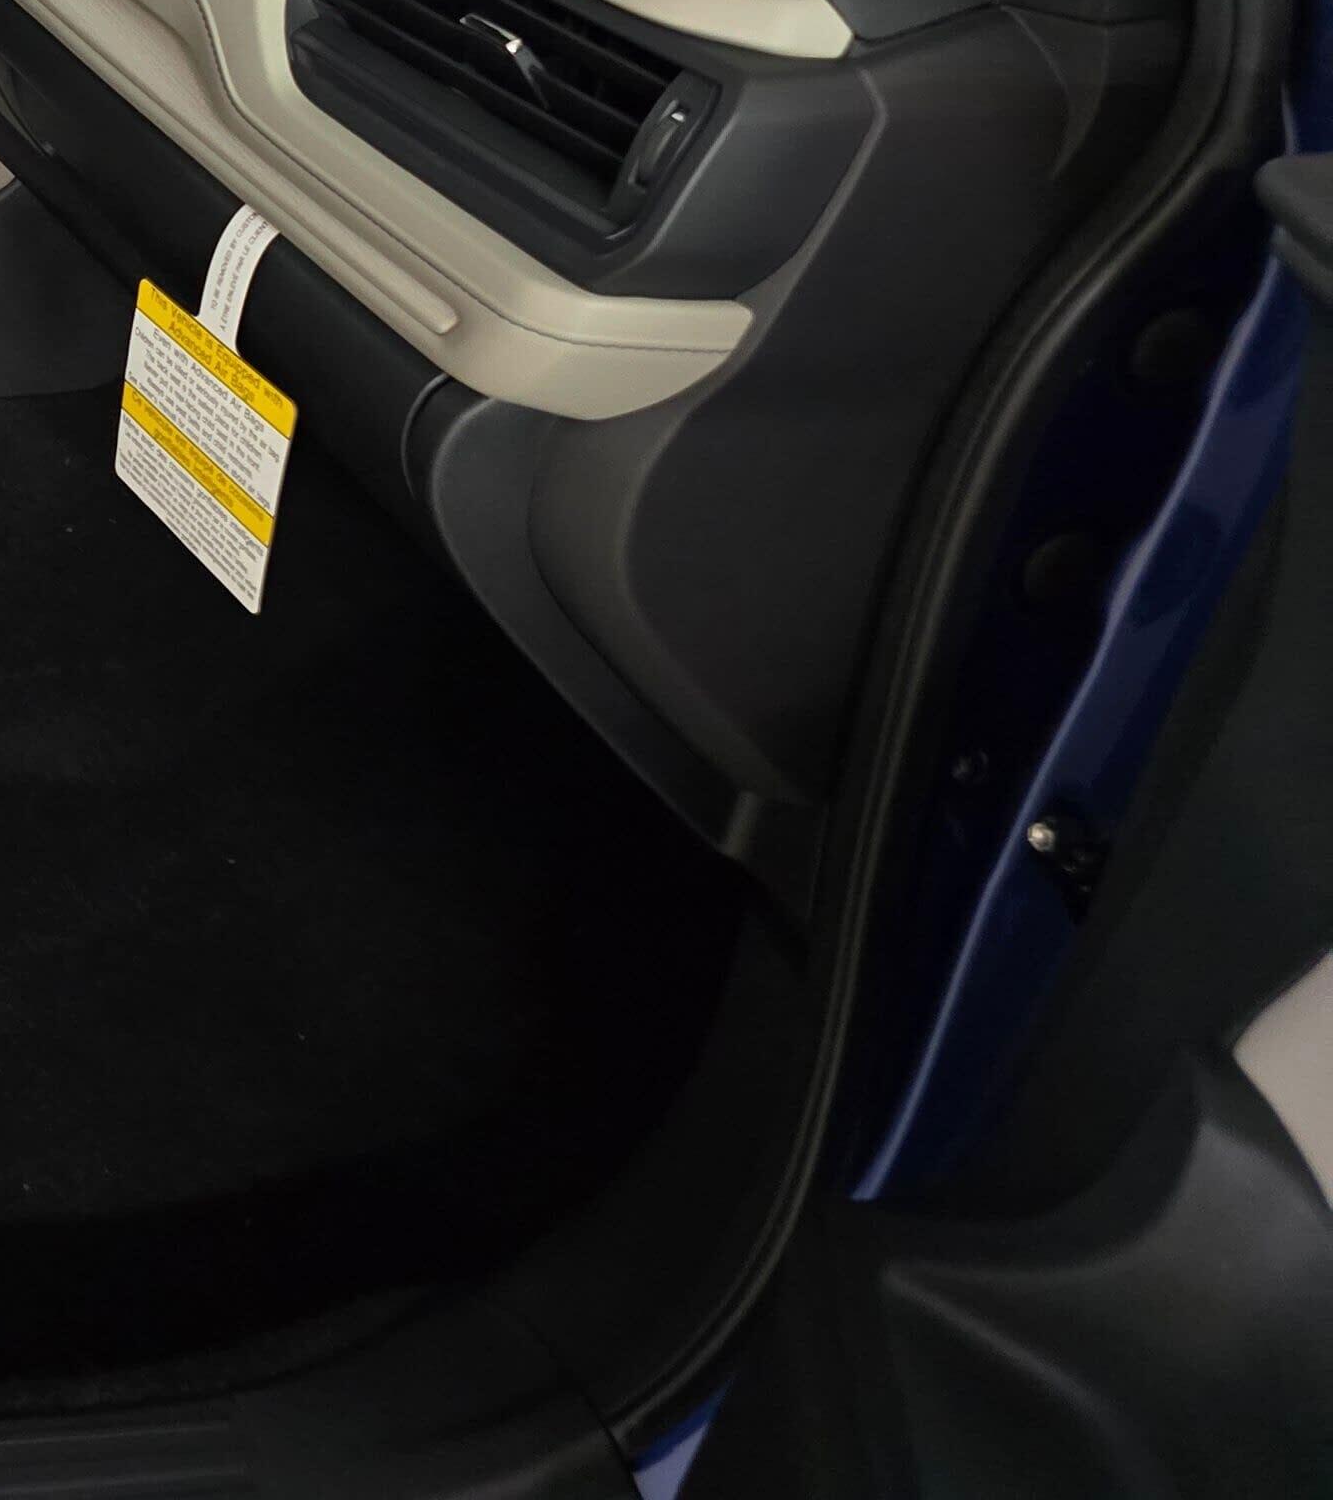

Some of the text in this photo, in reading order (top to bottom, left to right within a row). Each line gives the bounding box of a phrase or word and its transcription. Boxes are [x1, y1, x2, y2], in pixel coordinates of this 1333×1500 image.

[150, 287, 168, 312] This
[170, 304, 202, 341] Vehicle
[204, 334, 213, 350] is
[215, 343, 261, 391] Equipped
[153, 327, 264, 435] Even with Advanced Air Bags
[168, 318, 256, 406] Advanced Air Bags
